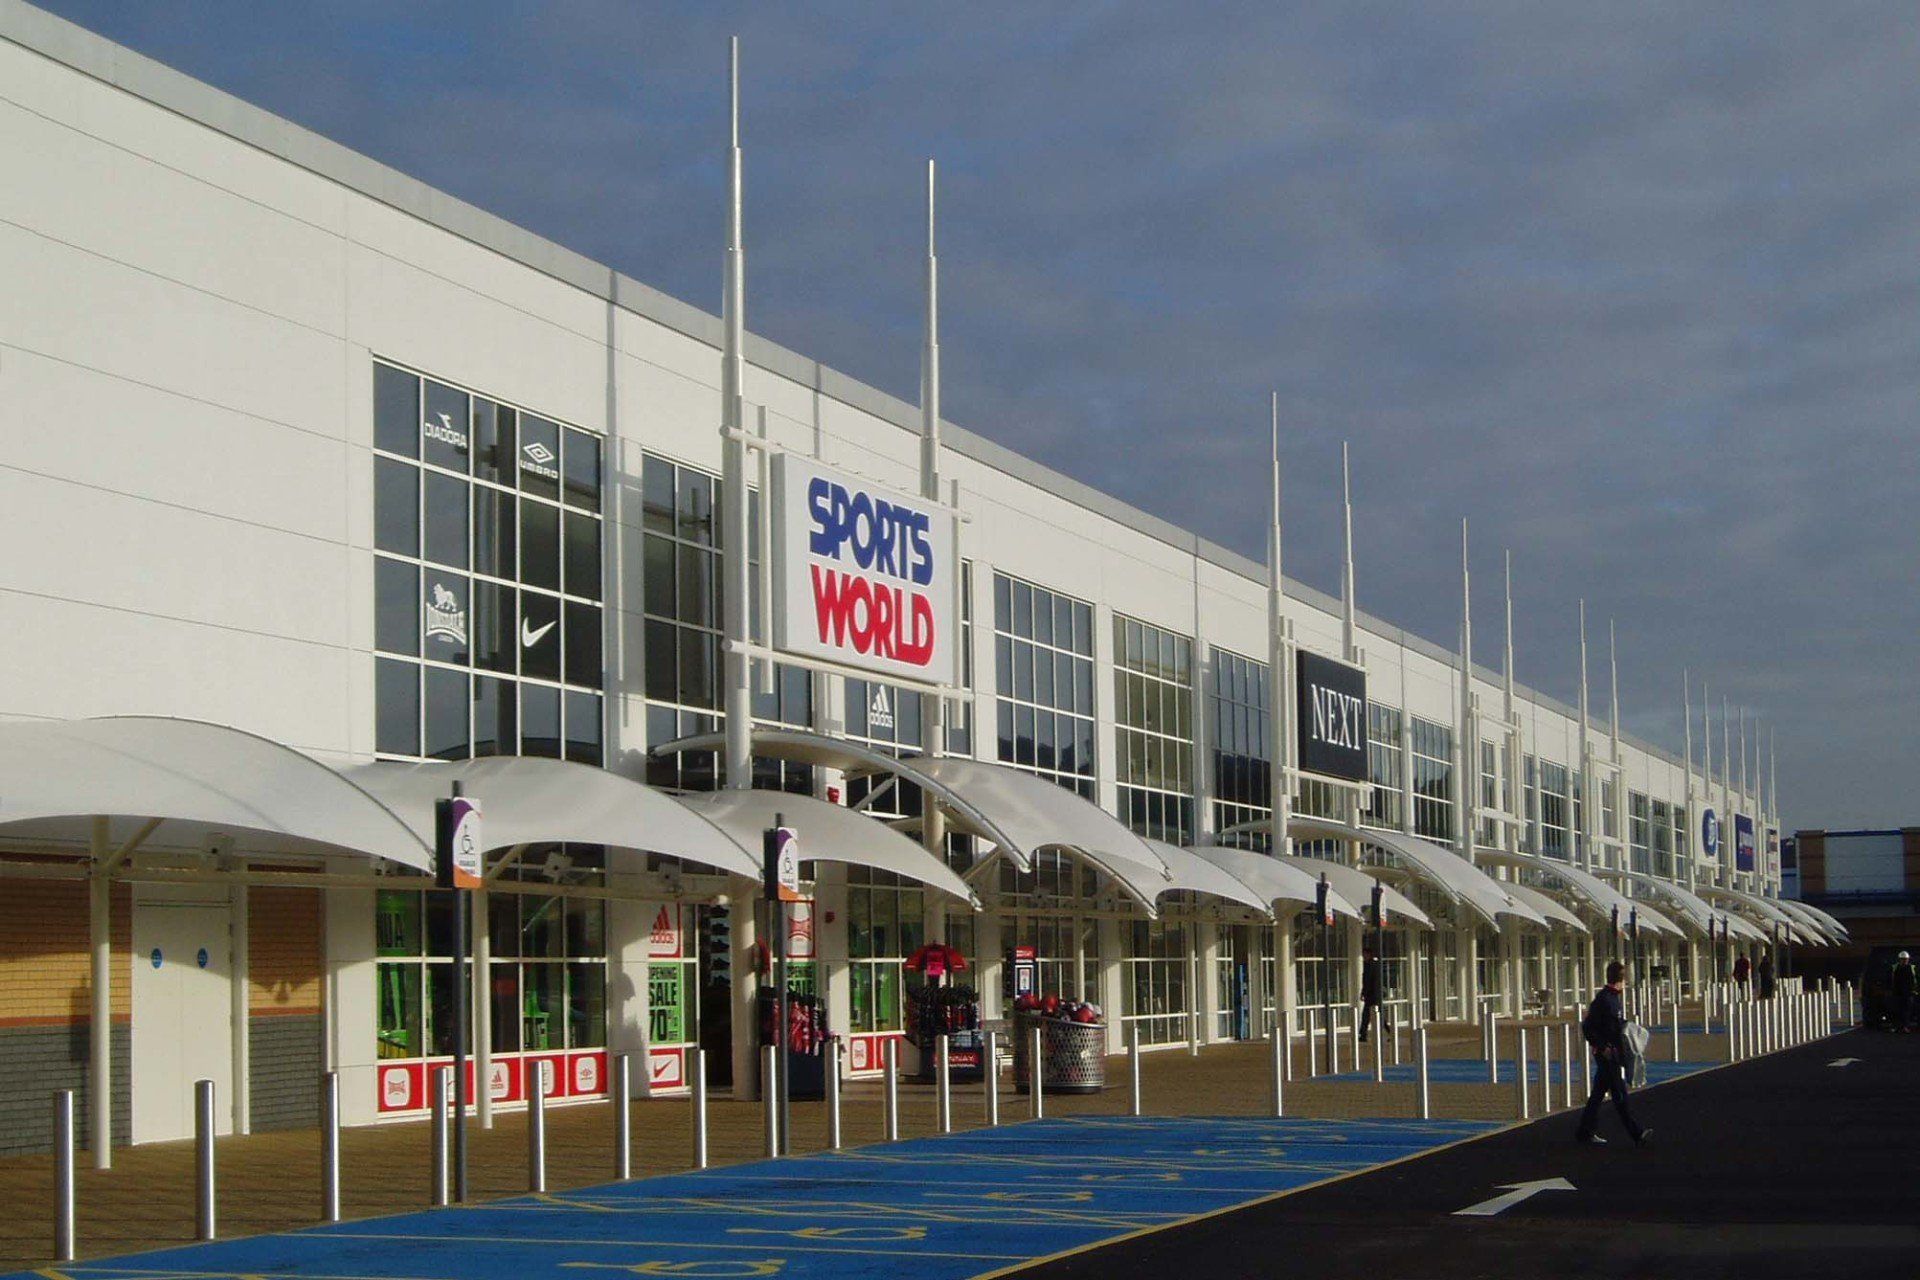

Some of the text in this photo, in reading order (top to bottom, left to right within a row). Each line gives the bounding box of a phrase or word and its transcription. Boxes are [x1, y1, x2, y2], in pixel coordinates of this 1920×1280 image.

[424, 422, 467, 449] DIADORA
[808, 477, 933, 586] SPORTS
[810, 564, 934, 667] WORLD
[869, 712, 893, 729] adidas
[1311, 684, 1361, 750] NEXT
[649, 982, 677, 1006] SALE
